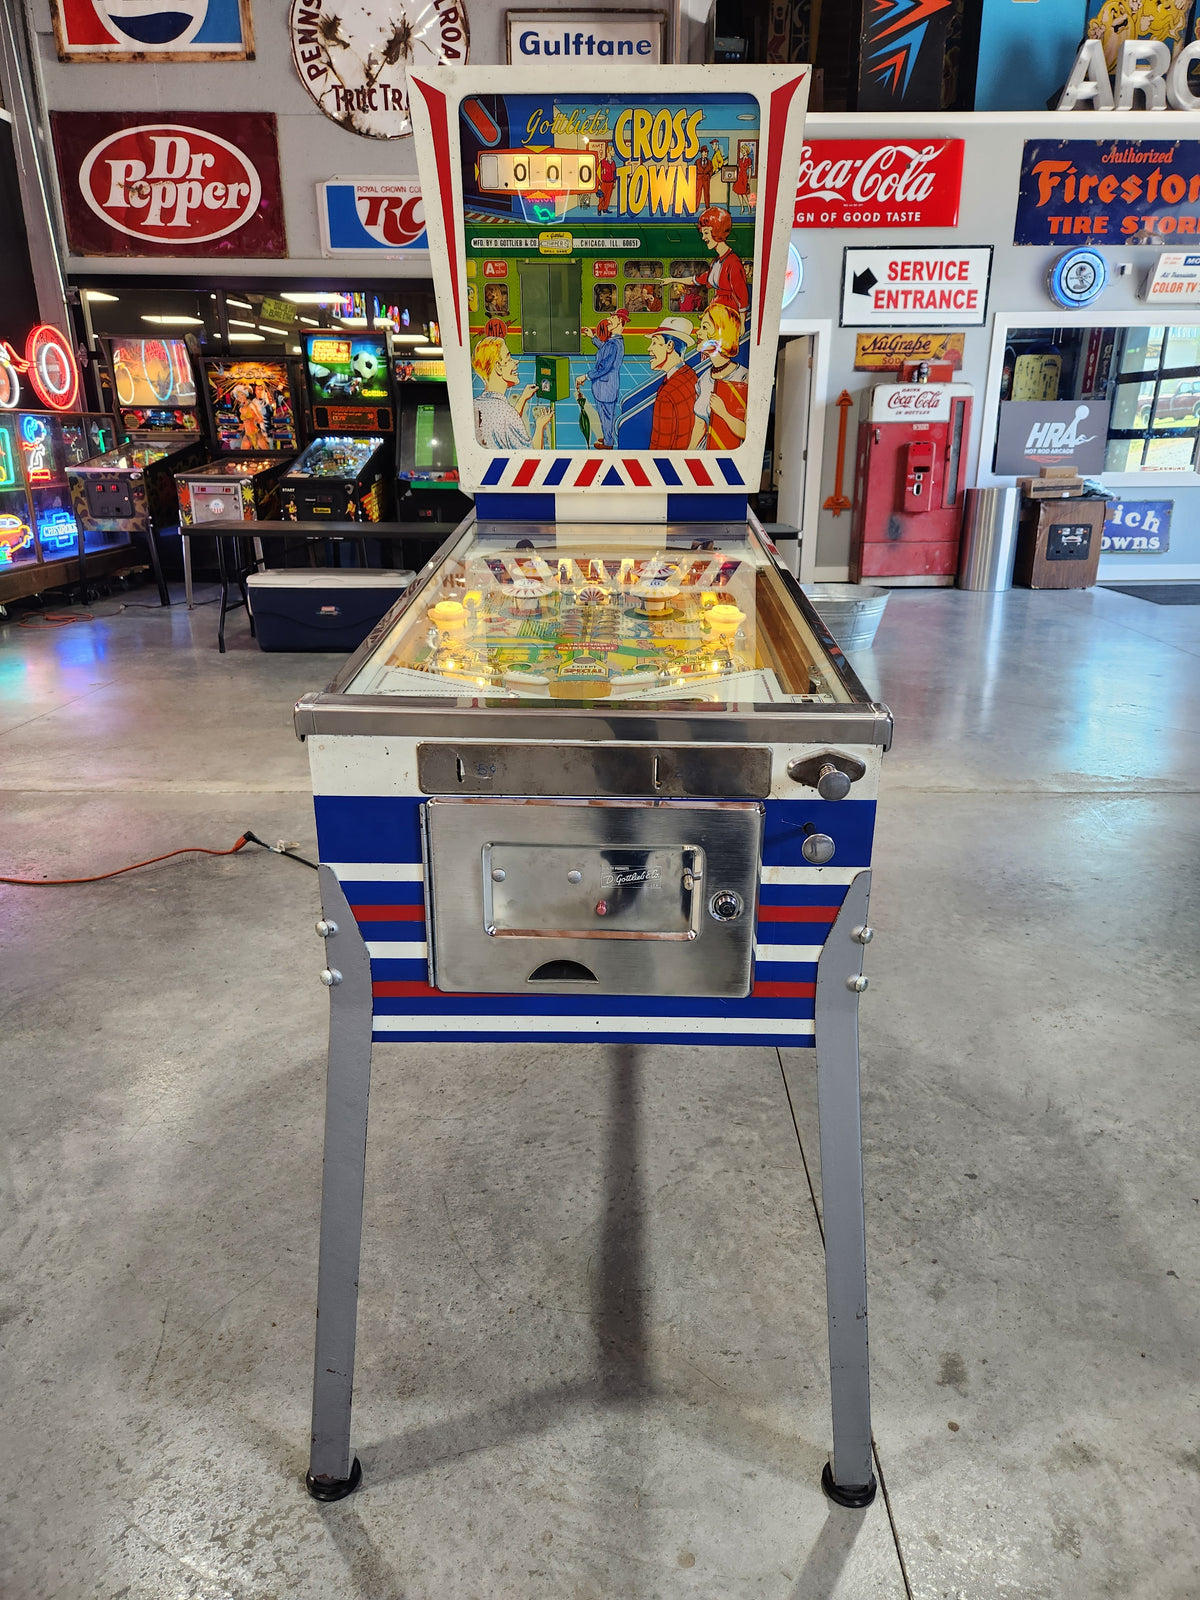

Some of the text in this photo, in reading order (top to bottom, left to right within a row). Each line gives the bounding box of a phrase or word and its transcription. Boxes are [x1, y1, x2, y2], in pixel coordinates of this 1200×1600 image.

[519, 30, 653, 56] Gulftane
[521, 108, 610, 144] Gottlieb's
[614, 108, 703, 161] CROSS
[149, 135, 215, 180] Dr
[1101, 147, 1175, 164] Authorized
[102, 158, 251, 228] Pepper
[356, 185, 379, 194] ROYAL
[380, 185, 407, 194] CROWN
[616, 164, 698, 215] TOWN
[357, 196, 426, 245] RC
[792, 211, 921, 223] GN OF GOOD TASTE
[1047, 216, 1110, 235] TIRE
[500, 239, 523, 248] GOTTLIEB
[887, 260, 970, 282] SERVICE
[873, 288, 979, 310] ENTRANCE
[1152, 281, 1198, 294] COLOR TV
[861, 334, 932, 358] NuGrape
[887, 390, 943, 410] Coca-Cola
[1025, 421, 1077, 449] HRA
[1112, 504, 1161, 534] ich
